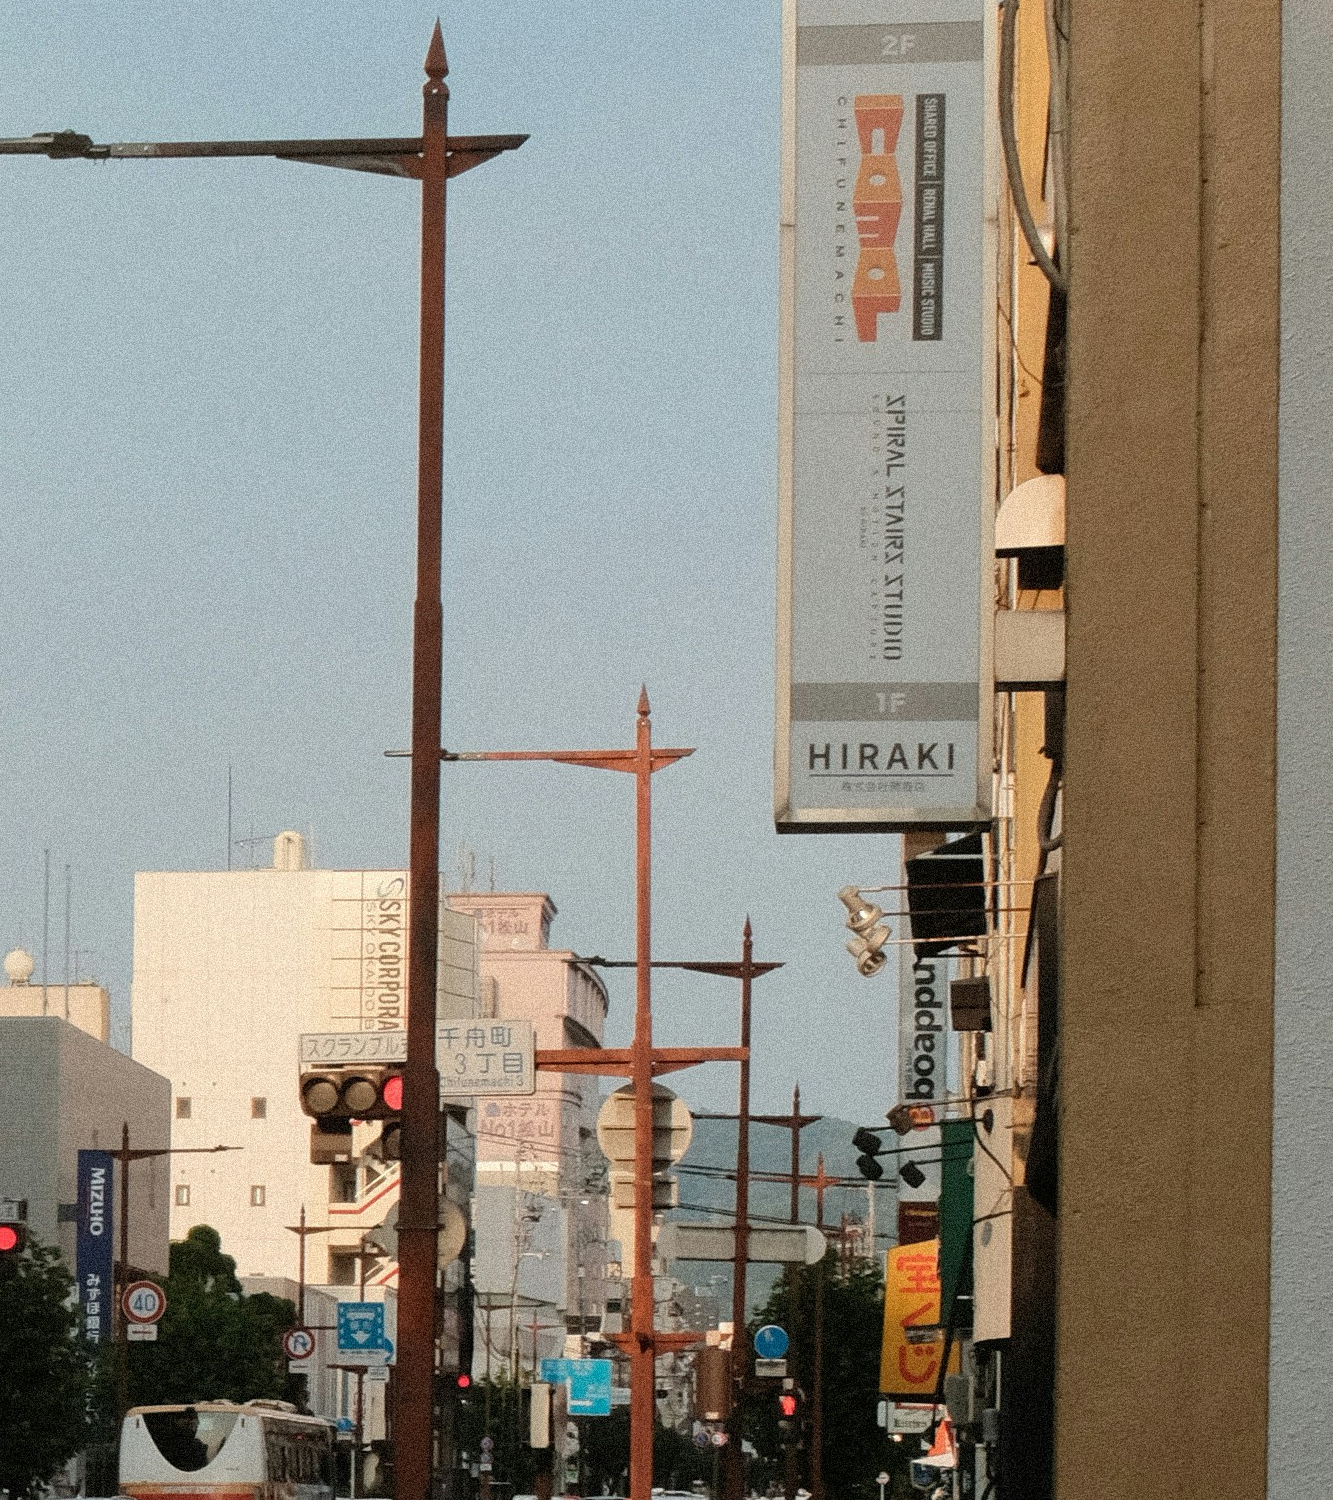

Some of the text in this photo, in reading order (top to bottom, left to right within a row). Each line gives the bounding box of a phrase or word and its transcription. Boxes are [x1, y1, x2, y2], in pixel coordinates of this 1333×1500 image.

[880, 35, 916, 57] 2F
[923, 97, 938, 140] SHARED
[922, 141, 937, 177] OFFICE
[834, 96, 848, 343] CHIFUNEMACHI
[921, 225, 935, 250] HALL
[921, 262, 935, 295] MUSIC
[920, 298, 935, 336] STUDIO
[882, 394, 906, 661] SPIRAL STAIRS STUDIO
[875, 691, 907, 714] 1F
[808, 742, 955, 771] HIRAKI
[378, 900, 402, 938] SKY
[437, 1026, 513, 1049] 千舟町
[454, 1052, 523, 1075] 3丁目
[515, 1075, 525, 1087] 3
[88, 1167, 106, 1237] MIZUHO
[131, 1293, 156, 1313] 40
